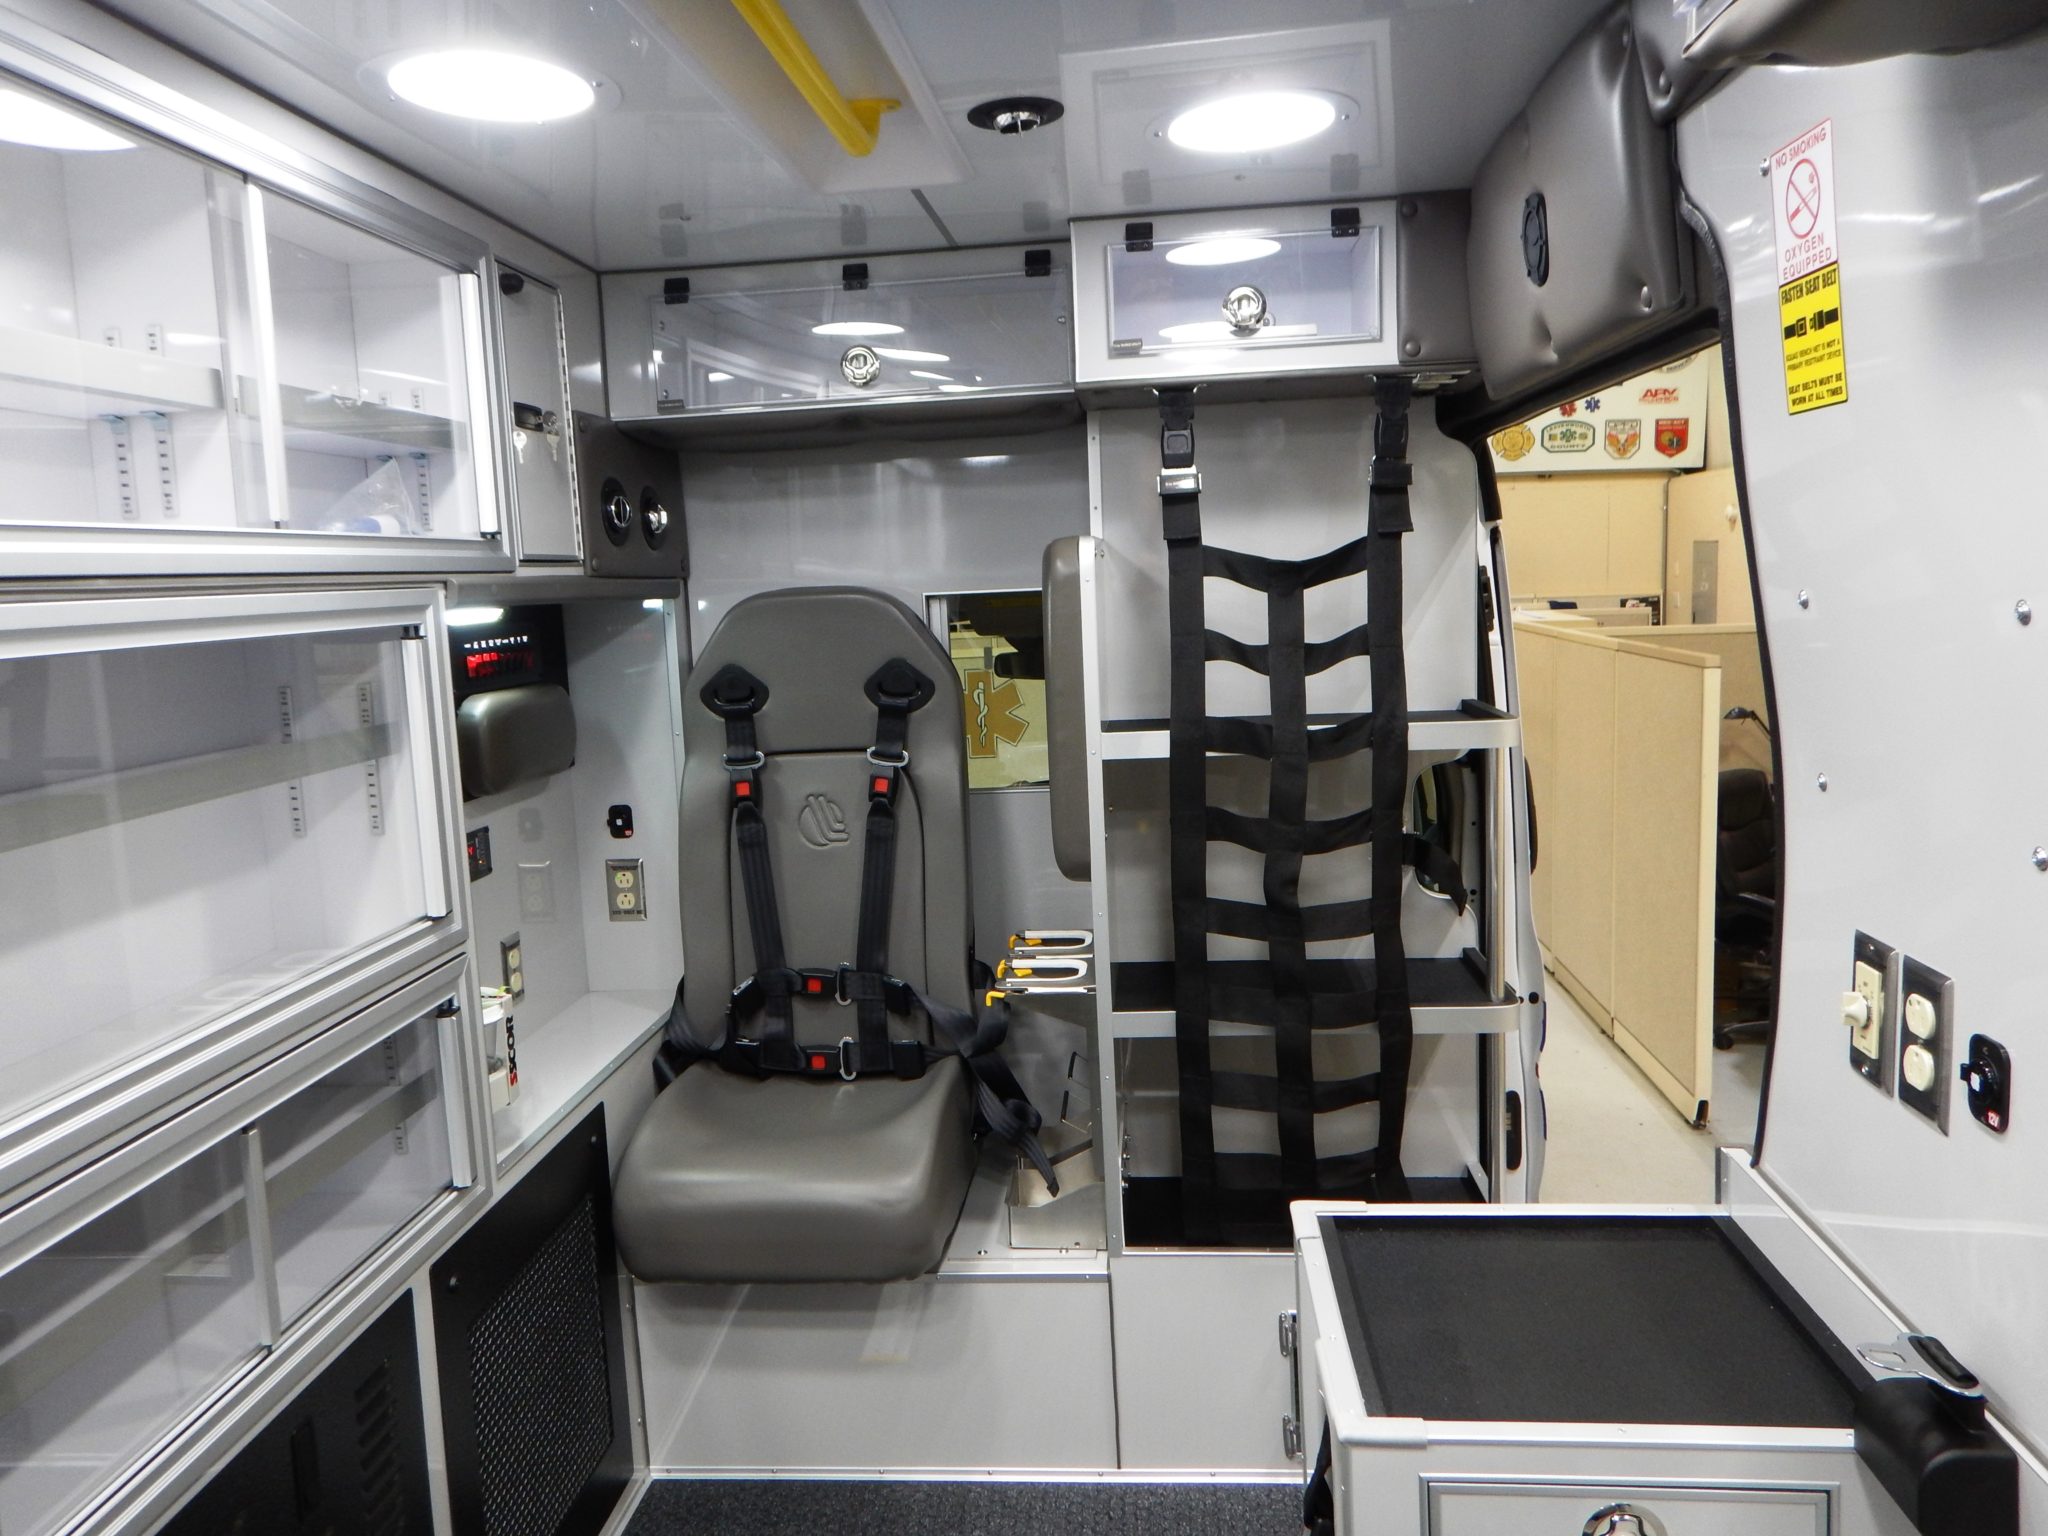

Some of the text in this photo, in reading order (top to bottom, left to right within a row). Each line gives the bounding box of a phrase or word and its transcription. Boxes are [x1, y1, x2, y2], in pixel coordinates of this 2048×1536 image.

[1775, 127, 1826, 169] NO SMOKING
[1785, 233, 1824, 262] OXYGEN
[1783, 247, 1832, 280] EQUIPPED
[1781, 268, 1837, 305] FASTEN SEAT BELT
[1826, 339, 1836, 348] NOT
[1788, 372, 1842, 395] SEAT BELTS MUST BE
[1791, 395, 1806, 406] WORN
[1815, 391, 1825, 401] ALL
[1826, 386, 1843, 397] TIMES
[506, 1015, 518, 1087] SSCOR
